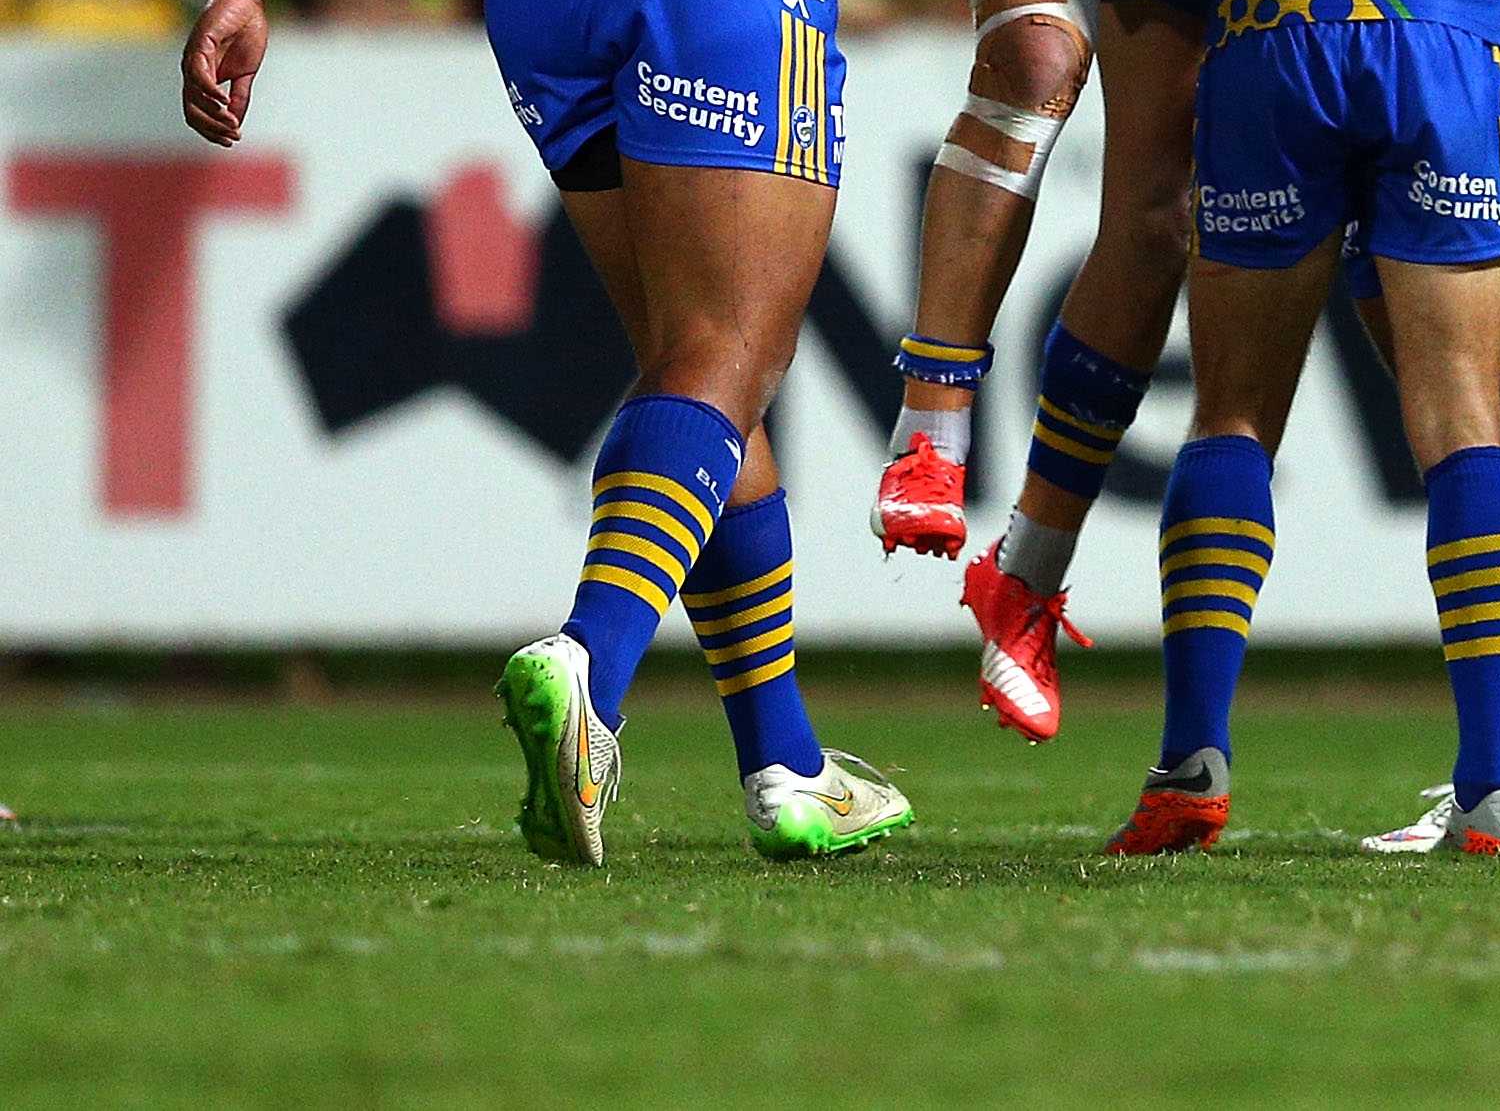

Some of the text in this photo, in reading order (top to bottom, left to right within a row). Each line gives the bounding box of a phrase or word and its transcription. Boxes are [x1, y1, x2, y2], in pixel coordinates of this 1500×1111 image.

[637, 61, 760, 117] Content
[637, 83, 766, 148] Security
[1200, 184, 1300, 210] Content
[1413, 160, 1498, 196] Conten
